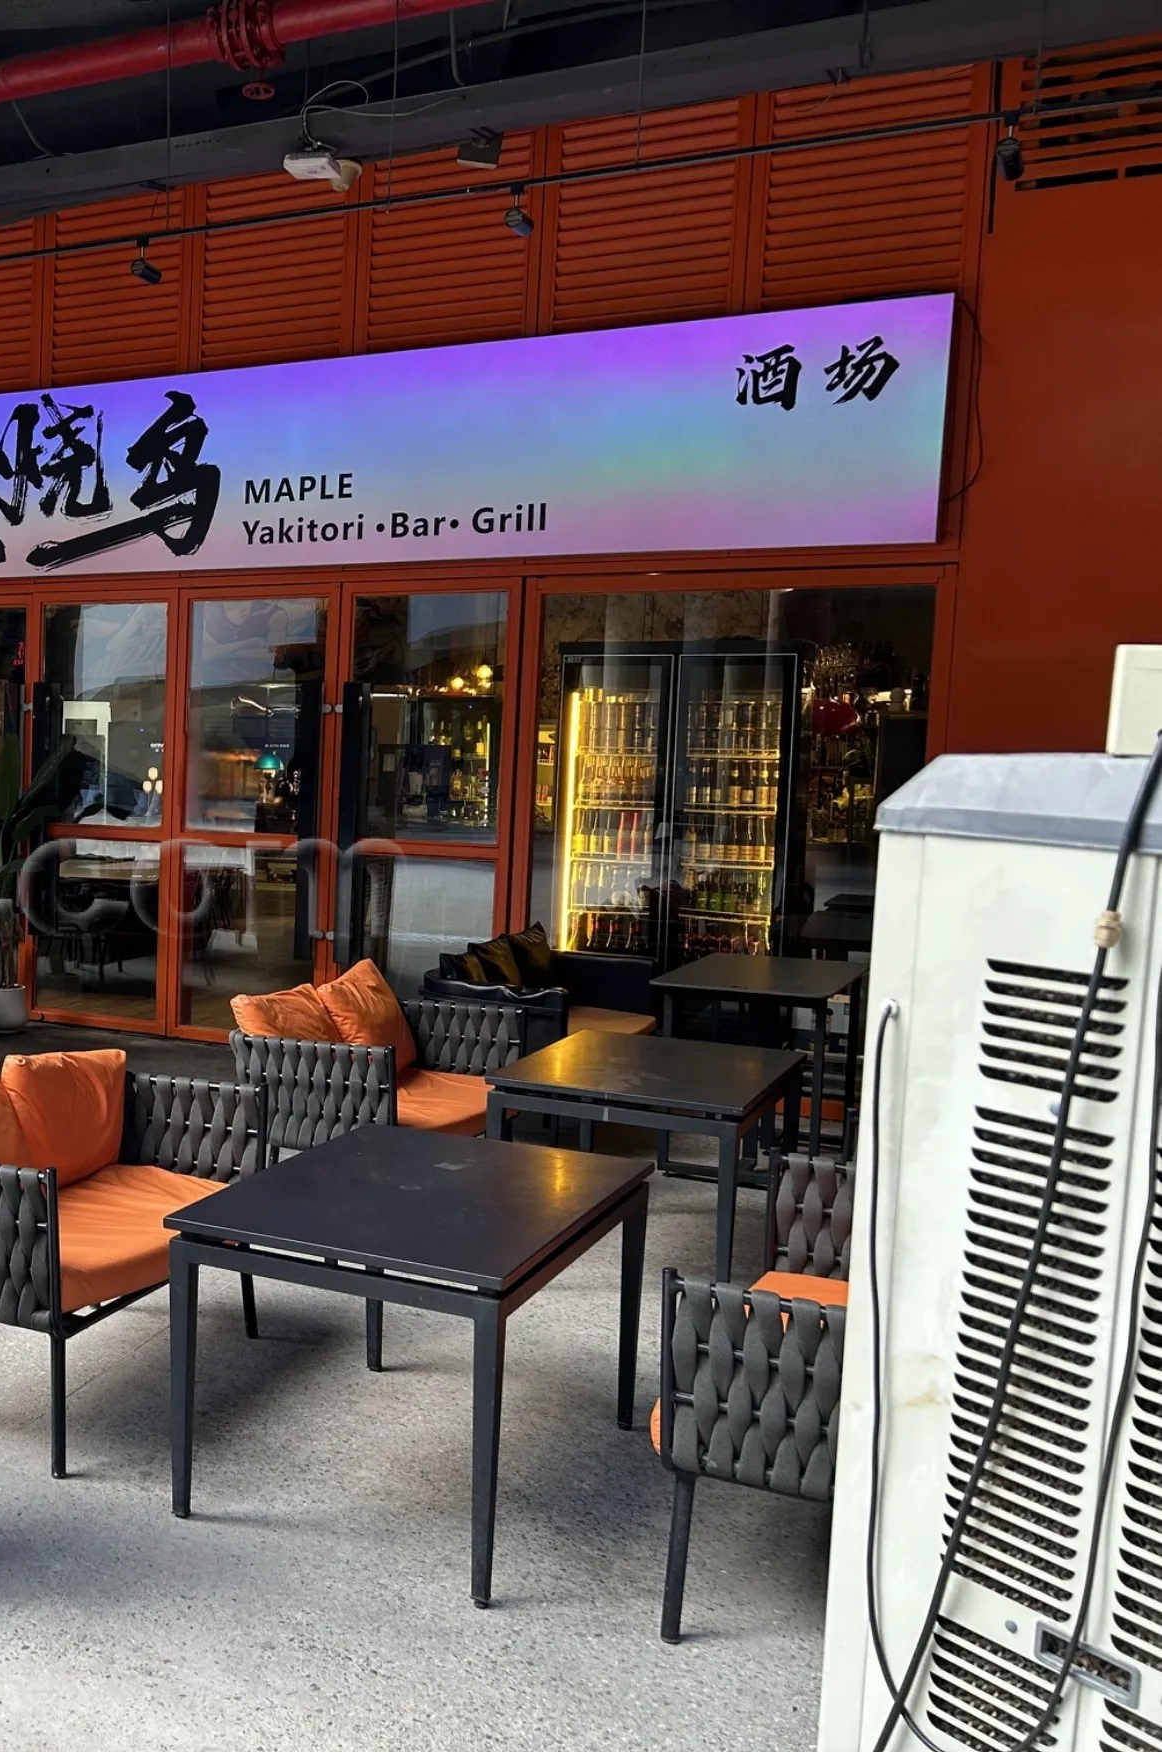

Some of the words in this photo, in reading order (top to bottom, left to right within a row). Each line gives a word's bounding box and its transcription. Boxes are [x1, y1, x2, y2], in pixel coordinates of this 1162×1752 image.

[735, 336, 900, 411] 酒场
[244, 473, 353, 504] MAPLE
[242, 513, 364, 545] Yakitori
[471, 503, 547, 534] Grill
